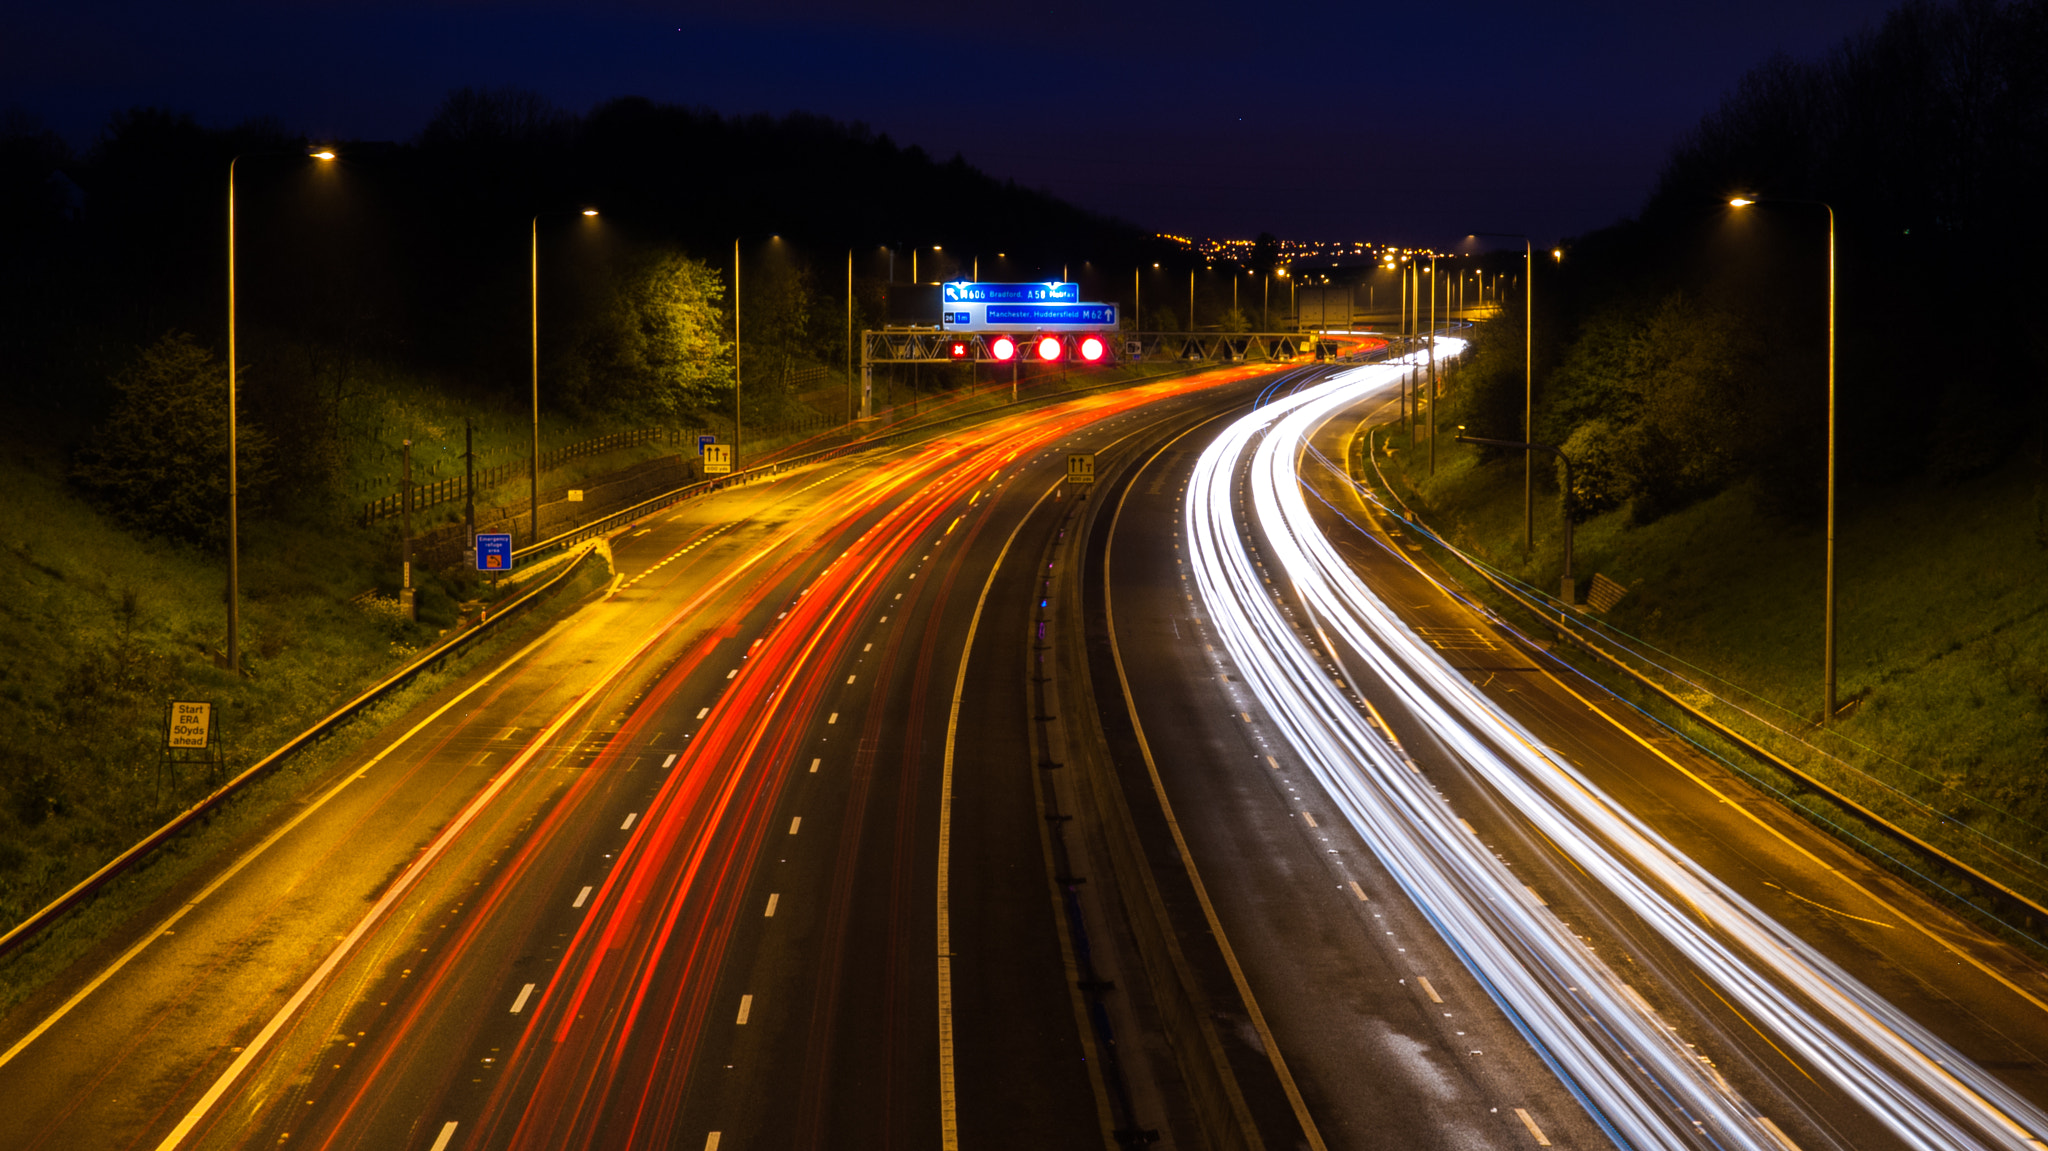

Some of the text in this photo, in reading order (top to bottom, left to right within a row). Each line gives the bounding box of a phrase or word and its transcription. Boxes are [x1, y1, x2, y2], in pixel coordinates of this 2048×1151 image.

[960, 289, 985, 299] M606
[179, 705, 203, 713] Start
[180, 715, 199, 724] ERA
[174, 726, 204, 736] 50yds
[173, 737, 203, 745] ahead
